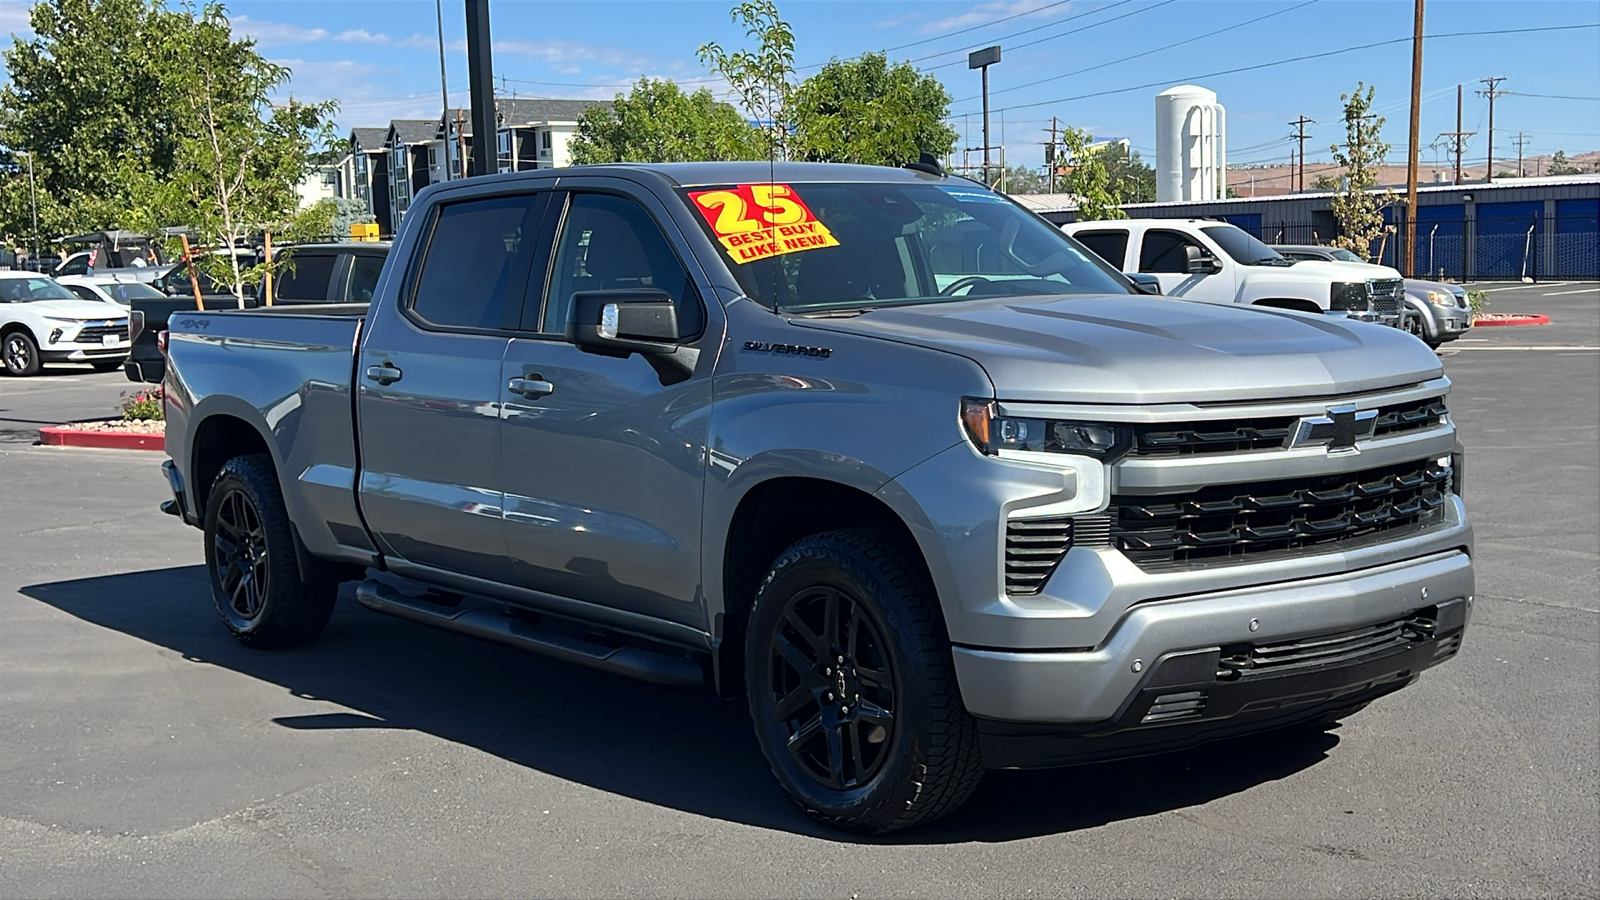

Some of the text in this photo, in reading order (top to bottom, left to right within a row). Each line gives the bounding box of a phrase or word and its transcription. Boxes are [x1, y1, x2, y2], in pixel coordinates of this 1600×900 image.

[697, 185, 807, 234] 25
[728, 223, 816, 247] BEST BUY
[739, 234, 827, 260] LIKE NEW
[743, 341, 833, 358] SILVERADO
